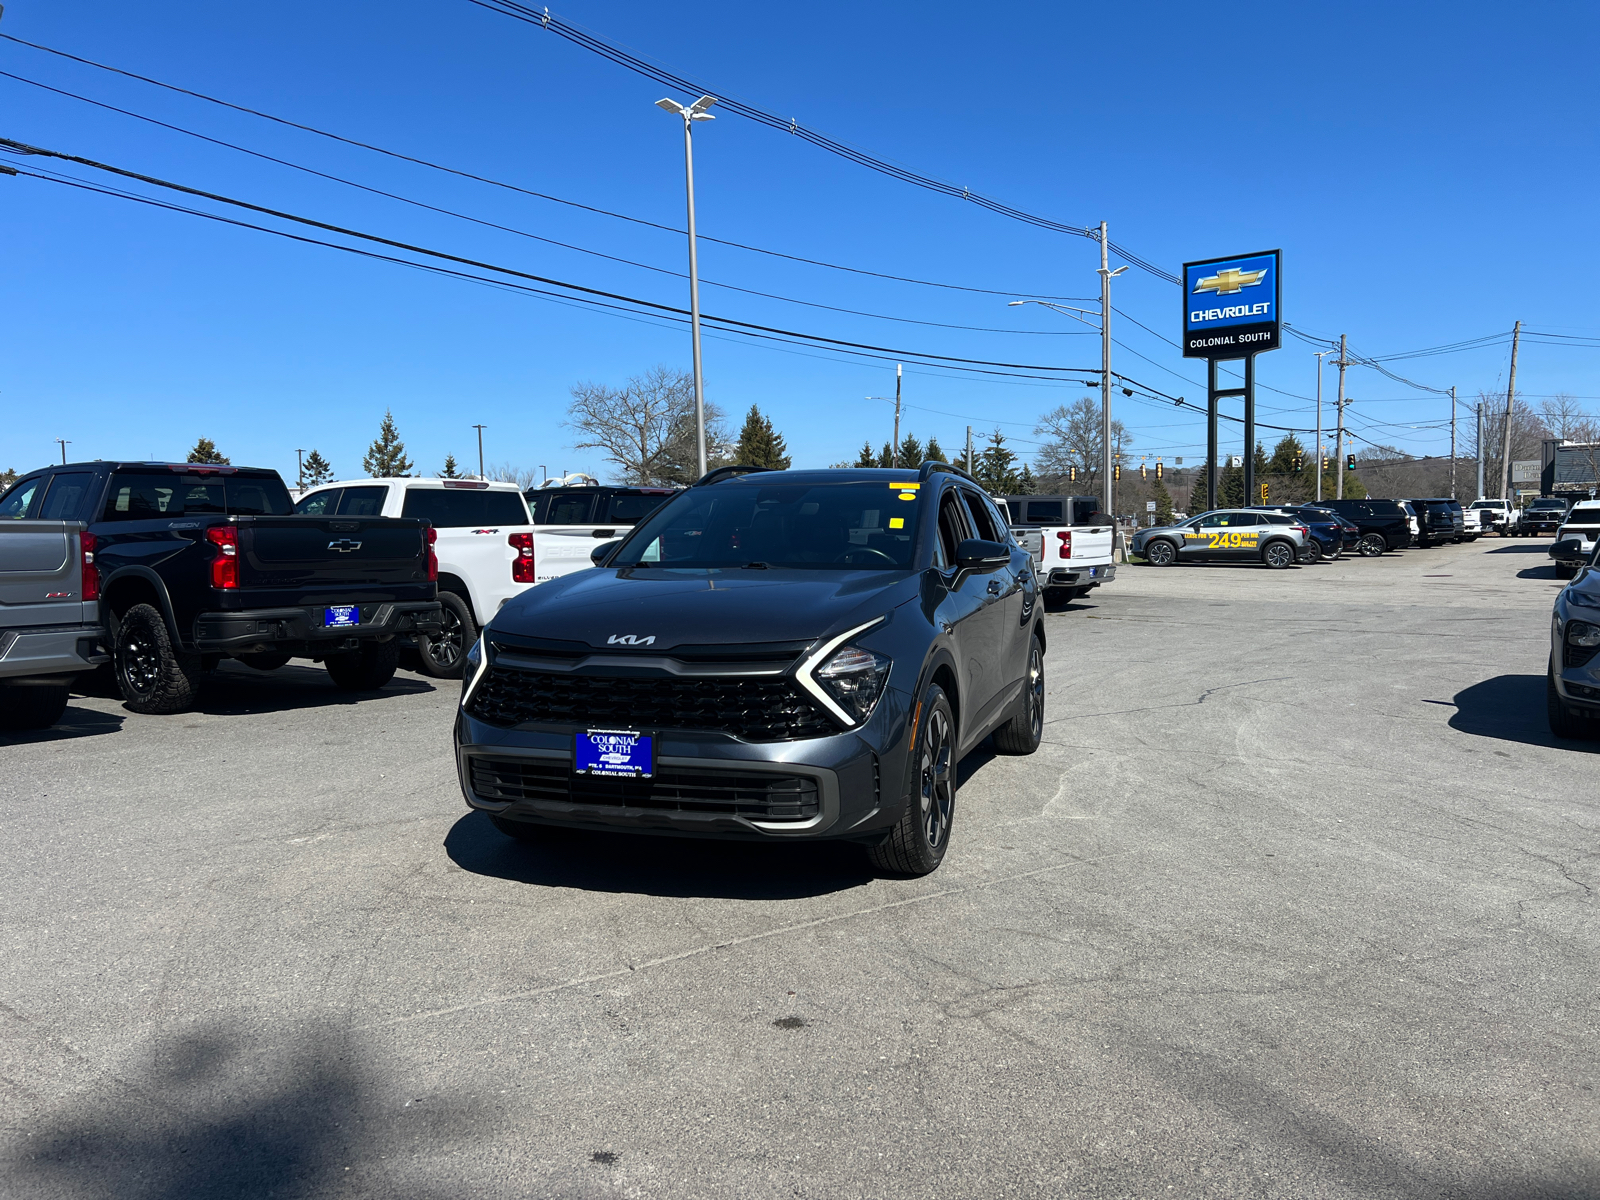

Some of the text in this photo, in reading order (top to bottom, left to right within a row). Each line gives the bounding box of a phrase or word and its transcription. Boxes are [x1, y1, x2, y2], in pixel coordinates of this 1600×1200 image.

[1191, 302, 1270, 322] CHEVROLET
[1190, 332, 1270, 348] COLONIAL SOUTH
[607, 634, 656, 645] KIA
[591, 735, 638, 745] COLONIAL
[598, 744, 631, 753] SOUTH
